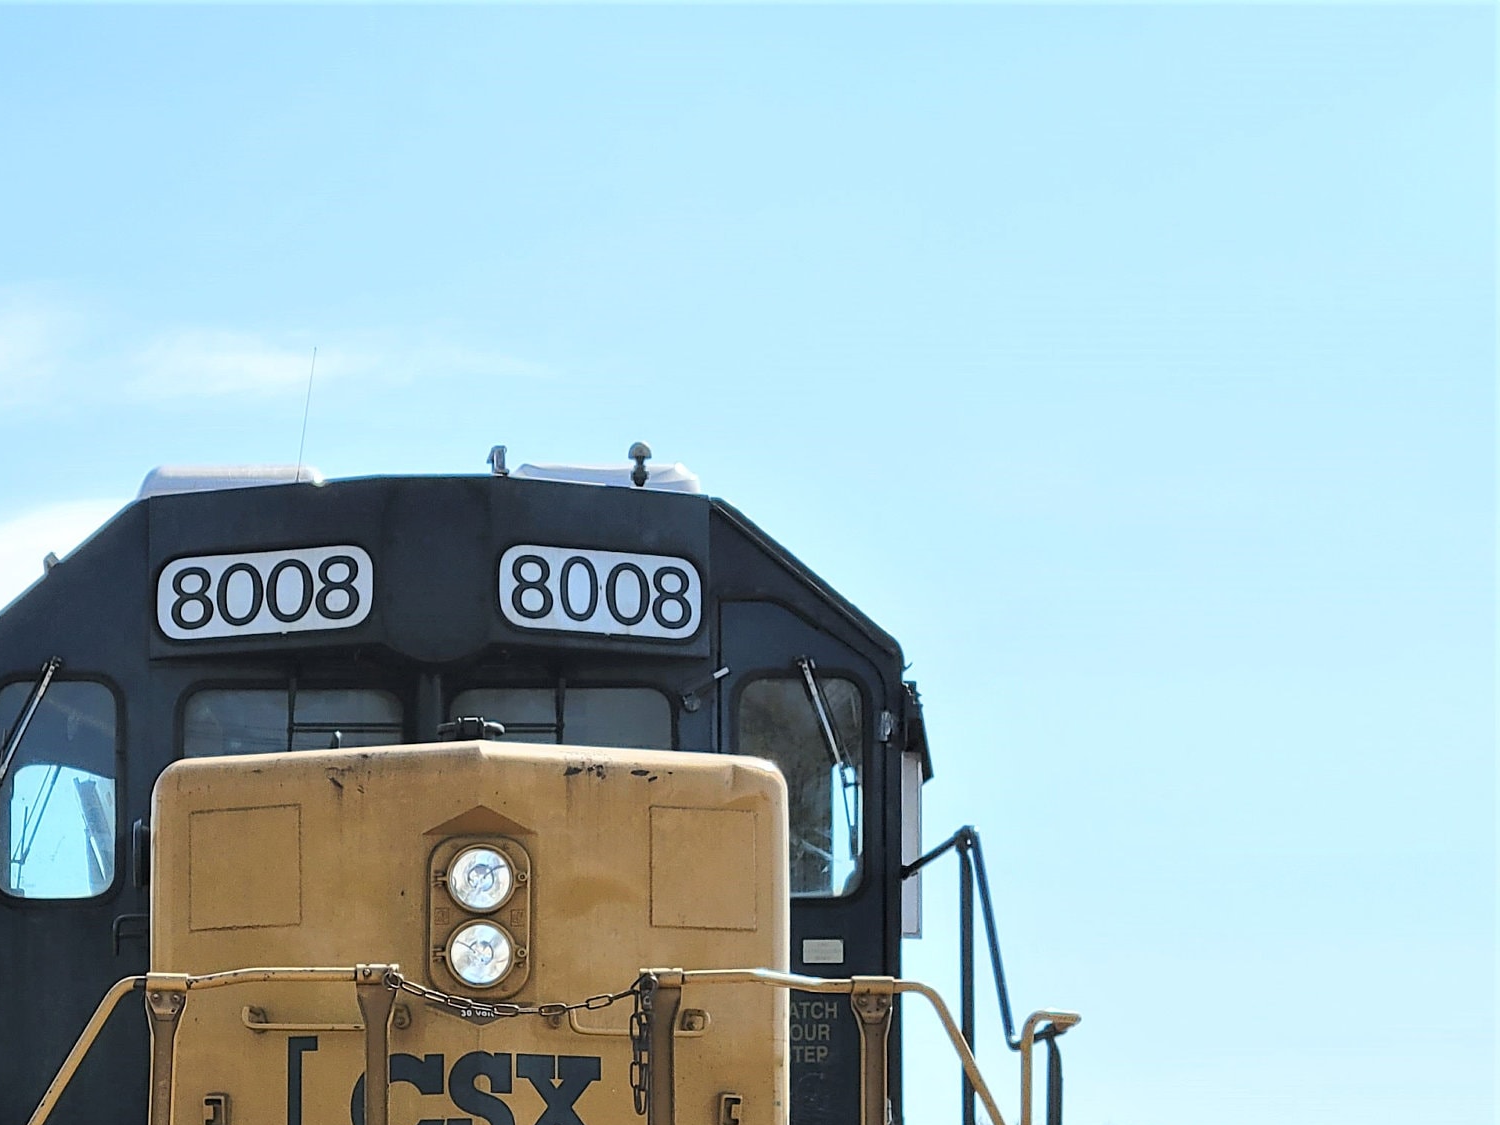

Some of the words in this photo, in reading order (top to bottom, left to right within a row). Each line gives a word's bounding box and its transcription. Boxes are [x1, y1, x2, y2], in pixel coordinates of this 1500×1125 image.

[171, 555, 360, 630] 8008
[511, 554, 692, 630] 8008
[461, 1009, 472, 1017] 30
[790, 1001, 838, 1019] ATCH
[790, 1024, 831, 1041] OUR
[790, 1045, 829, 1063] TEP
